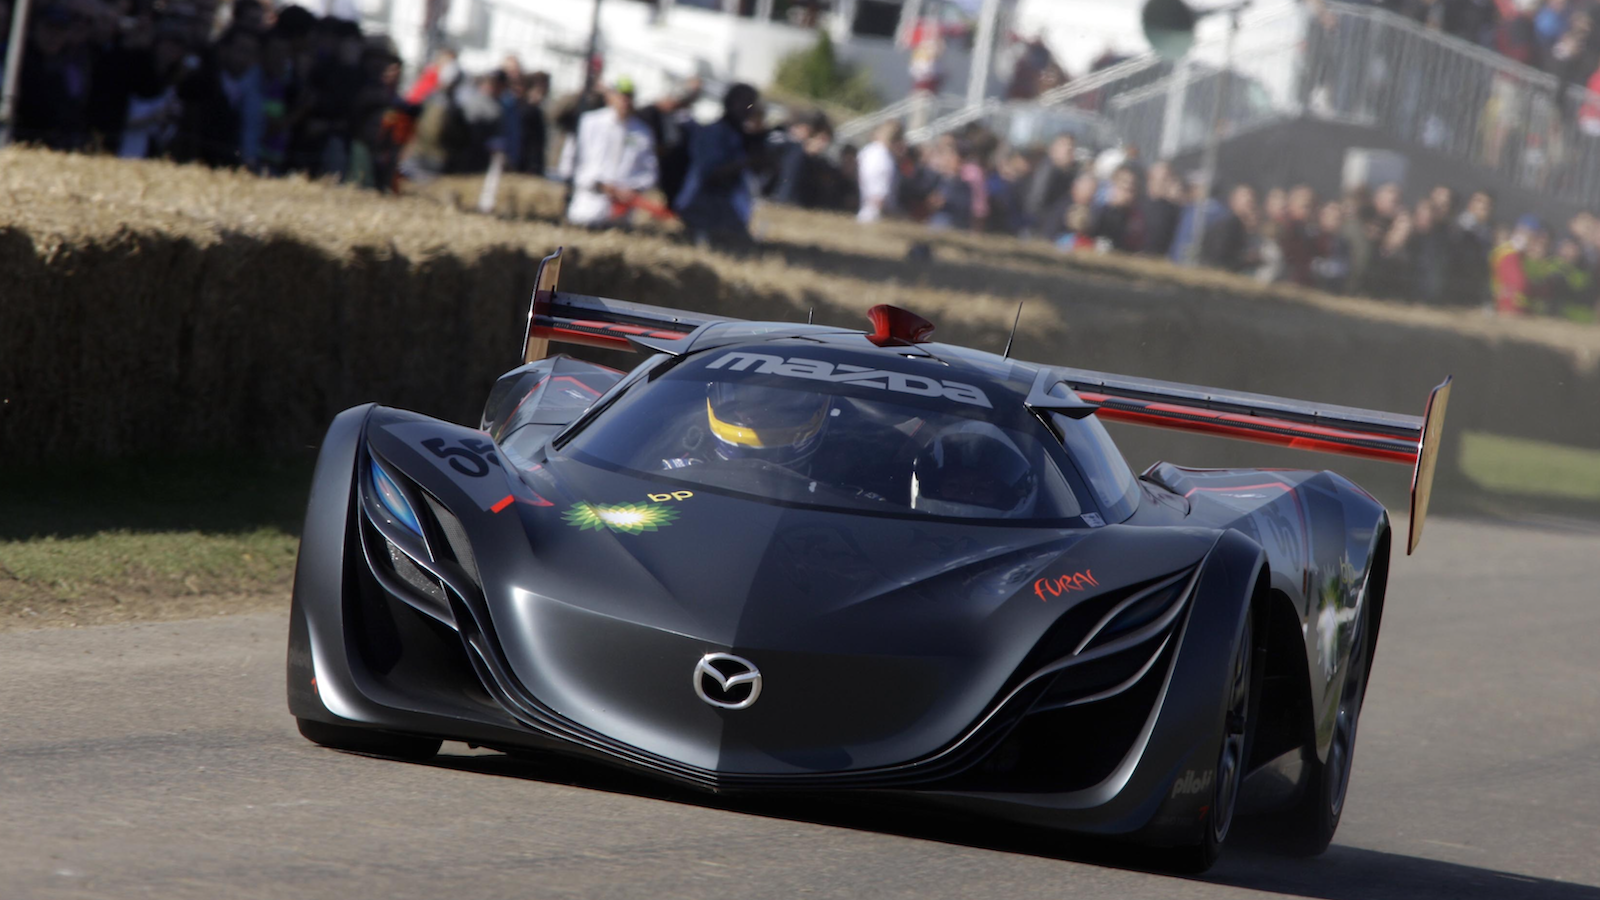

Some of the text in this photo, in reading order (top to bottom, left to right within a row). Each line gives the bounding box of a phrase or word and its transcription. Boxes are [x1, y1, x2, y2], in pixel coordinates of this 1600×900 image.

[420, 437, 502, 478] 55
[647, 490, 694, 502] bp
[1034, 569, 1100, 603] FURAI
[1171, 769, 1213, 799] piloti
